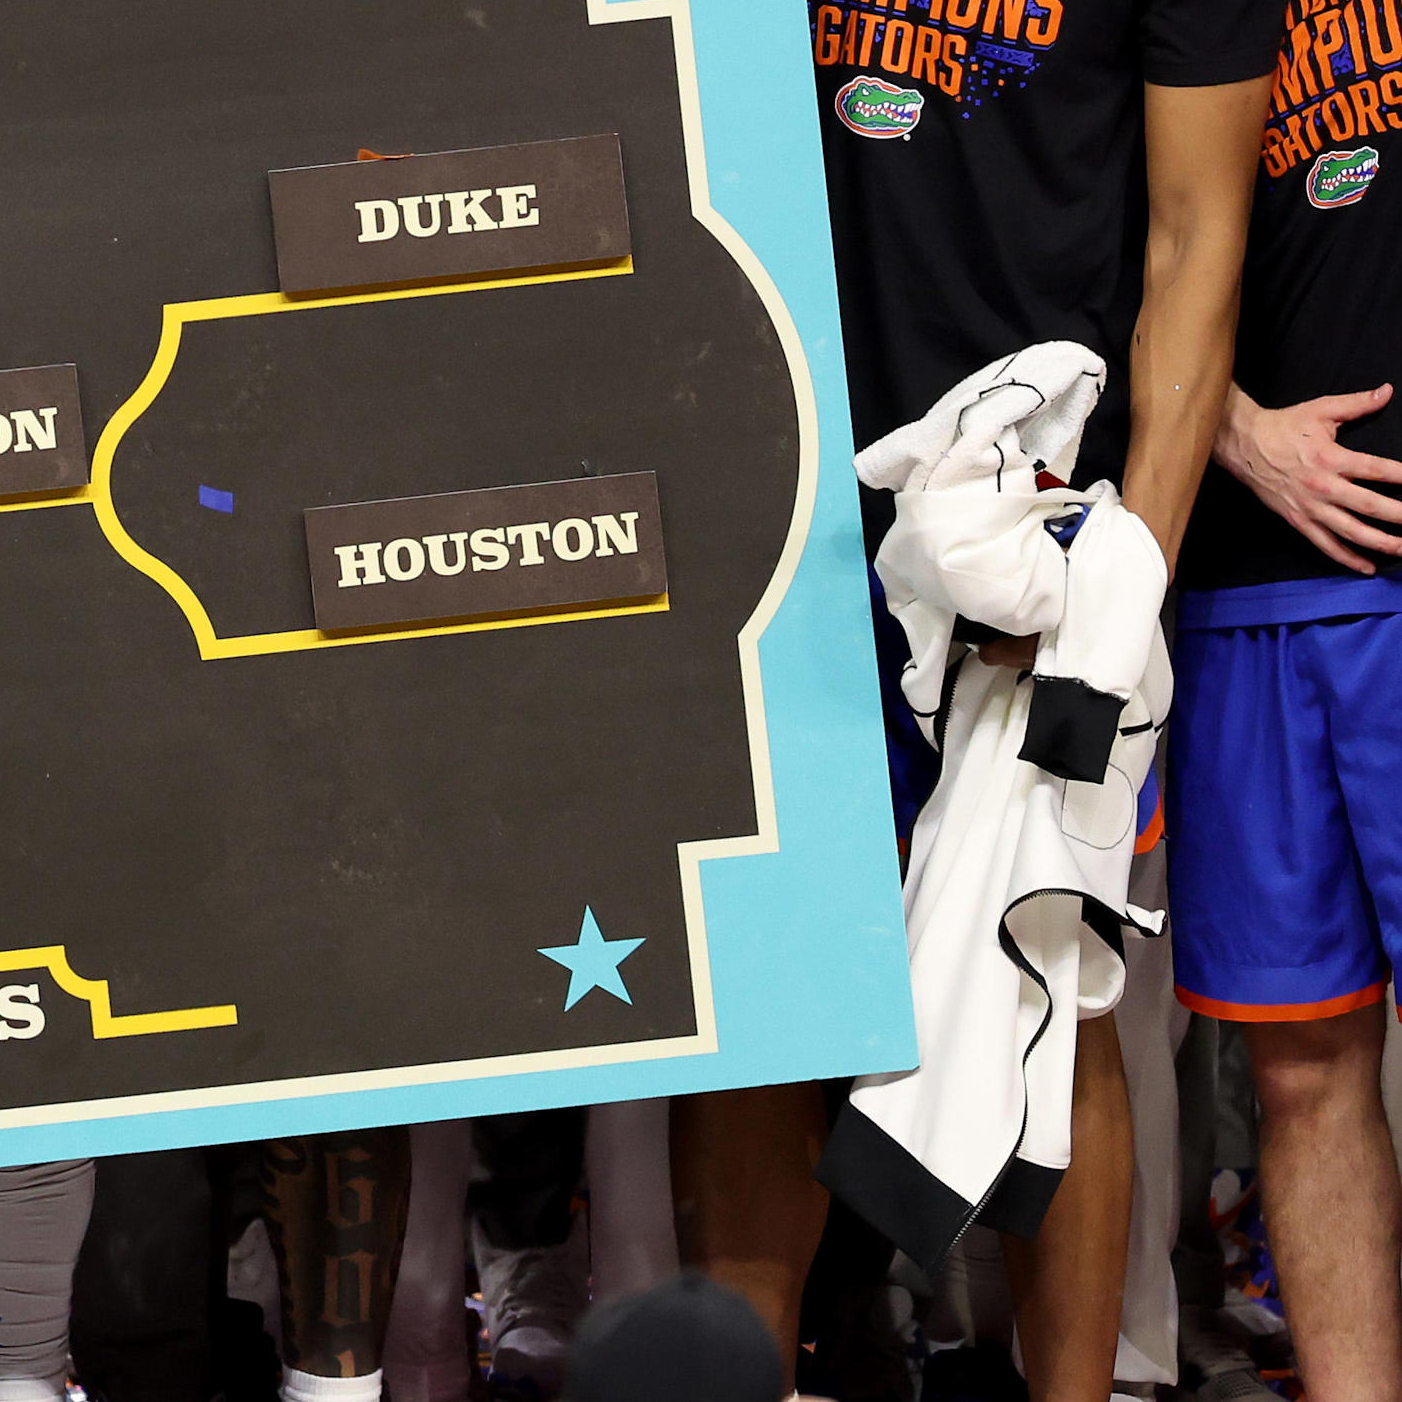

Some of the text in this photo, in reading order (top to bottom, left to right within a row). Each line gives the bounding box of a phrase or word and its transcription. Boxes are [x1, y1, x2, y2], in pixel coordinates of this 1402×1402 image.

[815, 4, 967, 98] GATORS
[354, 184, 540, 244] DUKE
[334, 511, 640, 588] HOUSTON
